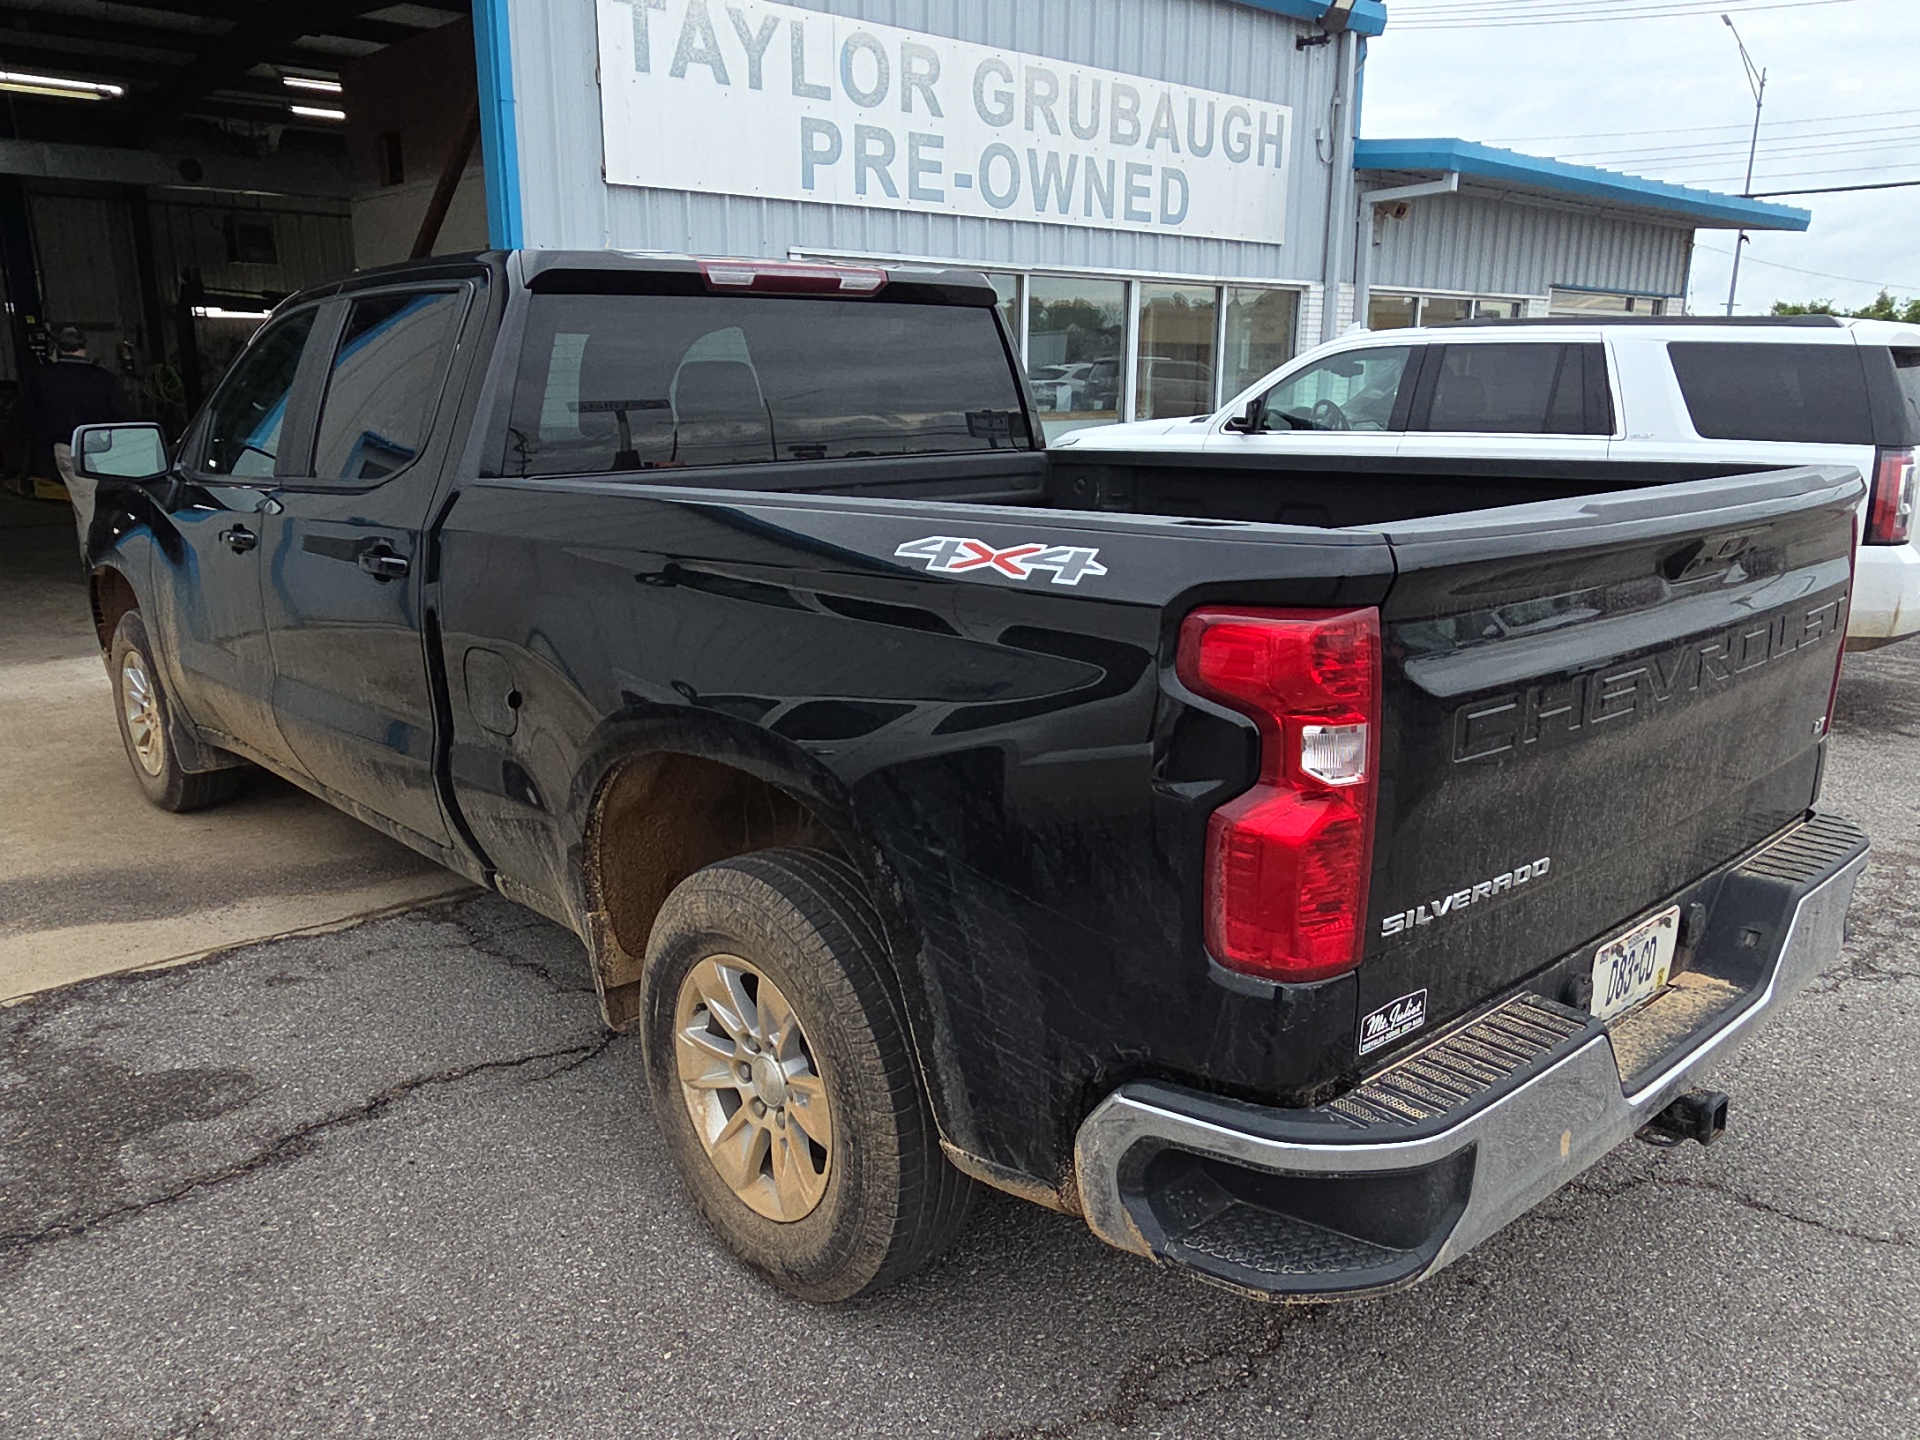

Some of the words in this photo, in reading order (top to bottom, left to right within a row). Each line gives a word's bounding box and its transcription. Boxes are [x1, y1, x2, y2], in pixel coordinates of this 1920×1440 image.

[612, 0, 943, 118] TAYLOR
[972, 57, 1284, 170] GRUBAUGH
[801, 116, 1190, 226] PRE-OWNED
[1453, 591, 1847, 763] CHEVROLET
[1381, 856, 1550, 937] SILVERADO
